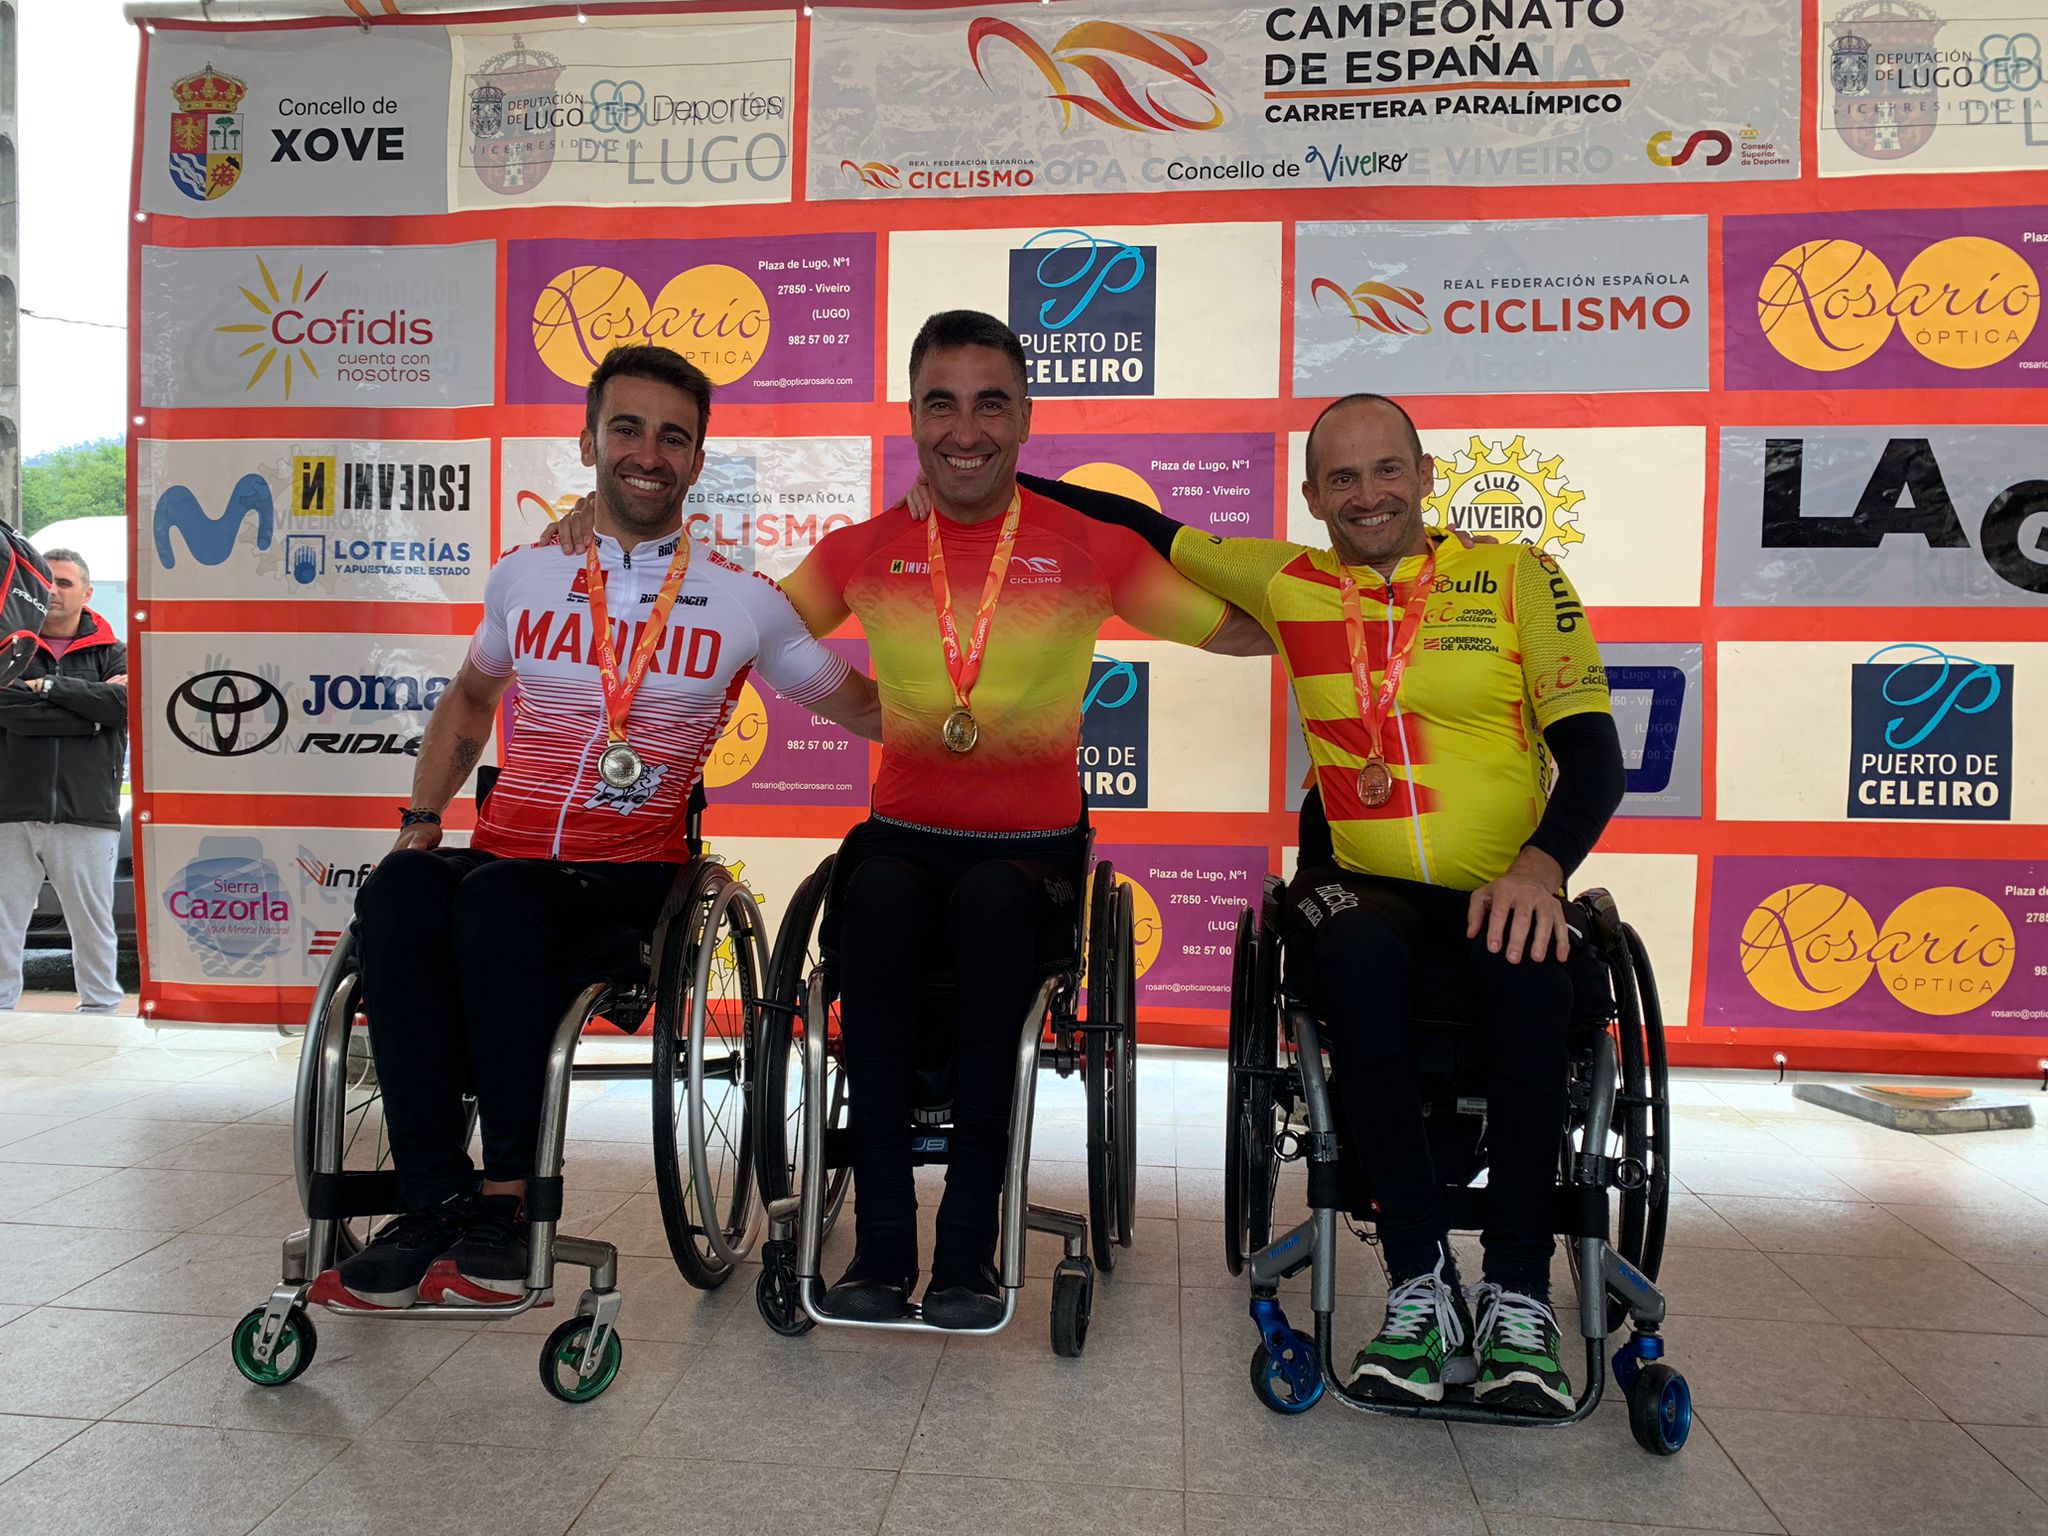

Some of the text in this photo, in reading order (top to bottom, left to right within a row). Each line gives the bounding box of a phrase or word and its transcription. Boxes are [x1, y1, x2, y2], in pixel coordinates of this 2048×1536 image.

[1265, 0, 1624, 41] CAMPEONATO
[1265, 52, 1327, 86] DE
[1346, 33, 1539, 83] ESPAÑA
[1875, 49, 1972, 65] DEPUTACIÓN
[1875, 69, 1895, 81] DE
[1898, 66, 1973, 89] LUGO
[279, 97, 398, 116] Concello de
[508, 92, 584, 111] DEPUTACIÓN
[653, 92, 783, 127] Deportes
[1265, 91, 1622, 123] CARRETERA PARALÍMPICO
[507, 108, 584, 131] DE LUGO
[270, 127, 404, 162] XOVE
[1741, 143, 1773, 151] Consejo
[627, 131, 787, 186] LUGO
[933, 158, 988, 167] FEDERACIÓN
[989, 157, 1034, 166] ESPAÑOLA
[1741, 151, 1775, 159] Superior
[1753, 158, 1790, 167] Deportes
[1167, 161, 1265, 180] Concello
[1272, 160, 1301, 178] de
[908, 169, 1034, 190] CICLISMO
[2023, 232, 2048, 243] Plaz
[758, 259, 786, 271] Plaza
[787, 258, 800, 270] de
[802, 257, 831, 272] Lugo,
[777, 282, 850, 295] 27850 Viveiro
[1444, 272, 1690, 290] REAL FEDERACIÓN ESPAÑOLA
[812, 308, 850, 321] (LUGO)
[1443, 295, 1691, 335] CICLISMO
[271, 308, 434, 345] Cofidis
[788, 334, 850, 346] 982 57 00 27
[1019, 331, 1143, 353] PUERTO DE
[1916, 327, 2020, 345] ÓPTICA
[337, 352, 430, 365] cuenta con
[685, 350, 753, 365] PTICA
[337, 366, 431, 382] nosotros
[753, 376, 853, 388] rosario@opticarosario.com
[1151, 460, 1180, 471] Plaza
[1182, 460, 1196, 470] de
[1198, 460, 1229, 472] Lugo,
[344, 462, 470, 512] INVERSE
[1171, 486, 1203, 497] 27850
[1213, 485, 1251, 496] Viveiro
[1474, 474, 1520, 493] club
[689, 490, 856, 503] EDERACIÓN ESPAÑOLA
[1209, 512, 1250, 524] (LUGO)
[1451, 505, 1543, 529] VIVEIRO
[334, 537, 470, 562] LOTERÍAS
[342, 565, 401, 575] APUESTAS
[404, 566, 426, 576] DEL
[428, 566, 470, 576] ESTADO
[1010, 576, 1062, 584] CICLISMO
[1455, 615, 1497, 624] ciclismo
[515, 609, 722, 680] MADRID
[1440, 636, 1492, 645] GOBIERNO
[298, 733, 422, 757] RIDLE
[787, 740, 849, 750] 982 57 00 27
[1108, 746, 1136, 767] DE
[1861, 753, 1998, 776] PUERTO DE
[752, 781, 853, 792] rosario@opticarosario.com
[1858, 780, 1999, 807] CELEIRO
[1150, 868, 1178, 879] Plaza
[1180, 869, 1193, 879] de
[1196, 870, 1227, 882] Lugo,
[214, 878, 259, 893] Sierra
[2005, 885, 2036, 896] Plaza
[169, 890, 289, 922] Cazorla
[1170, 894, 1201, 905] 27850
[1210, 895, 1248, 906] Viveiro
[1208, 921, 1239, 932] (LUG
[1182, 945, 1232, 955] 982 57 00
[1145, 984, 1231, 993] rosario@opticarosario
[1893, 973, 1994, 993] ÓPTICA
